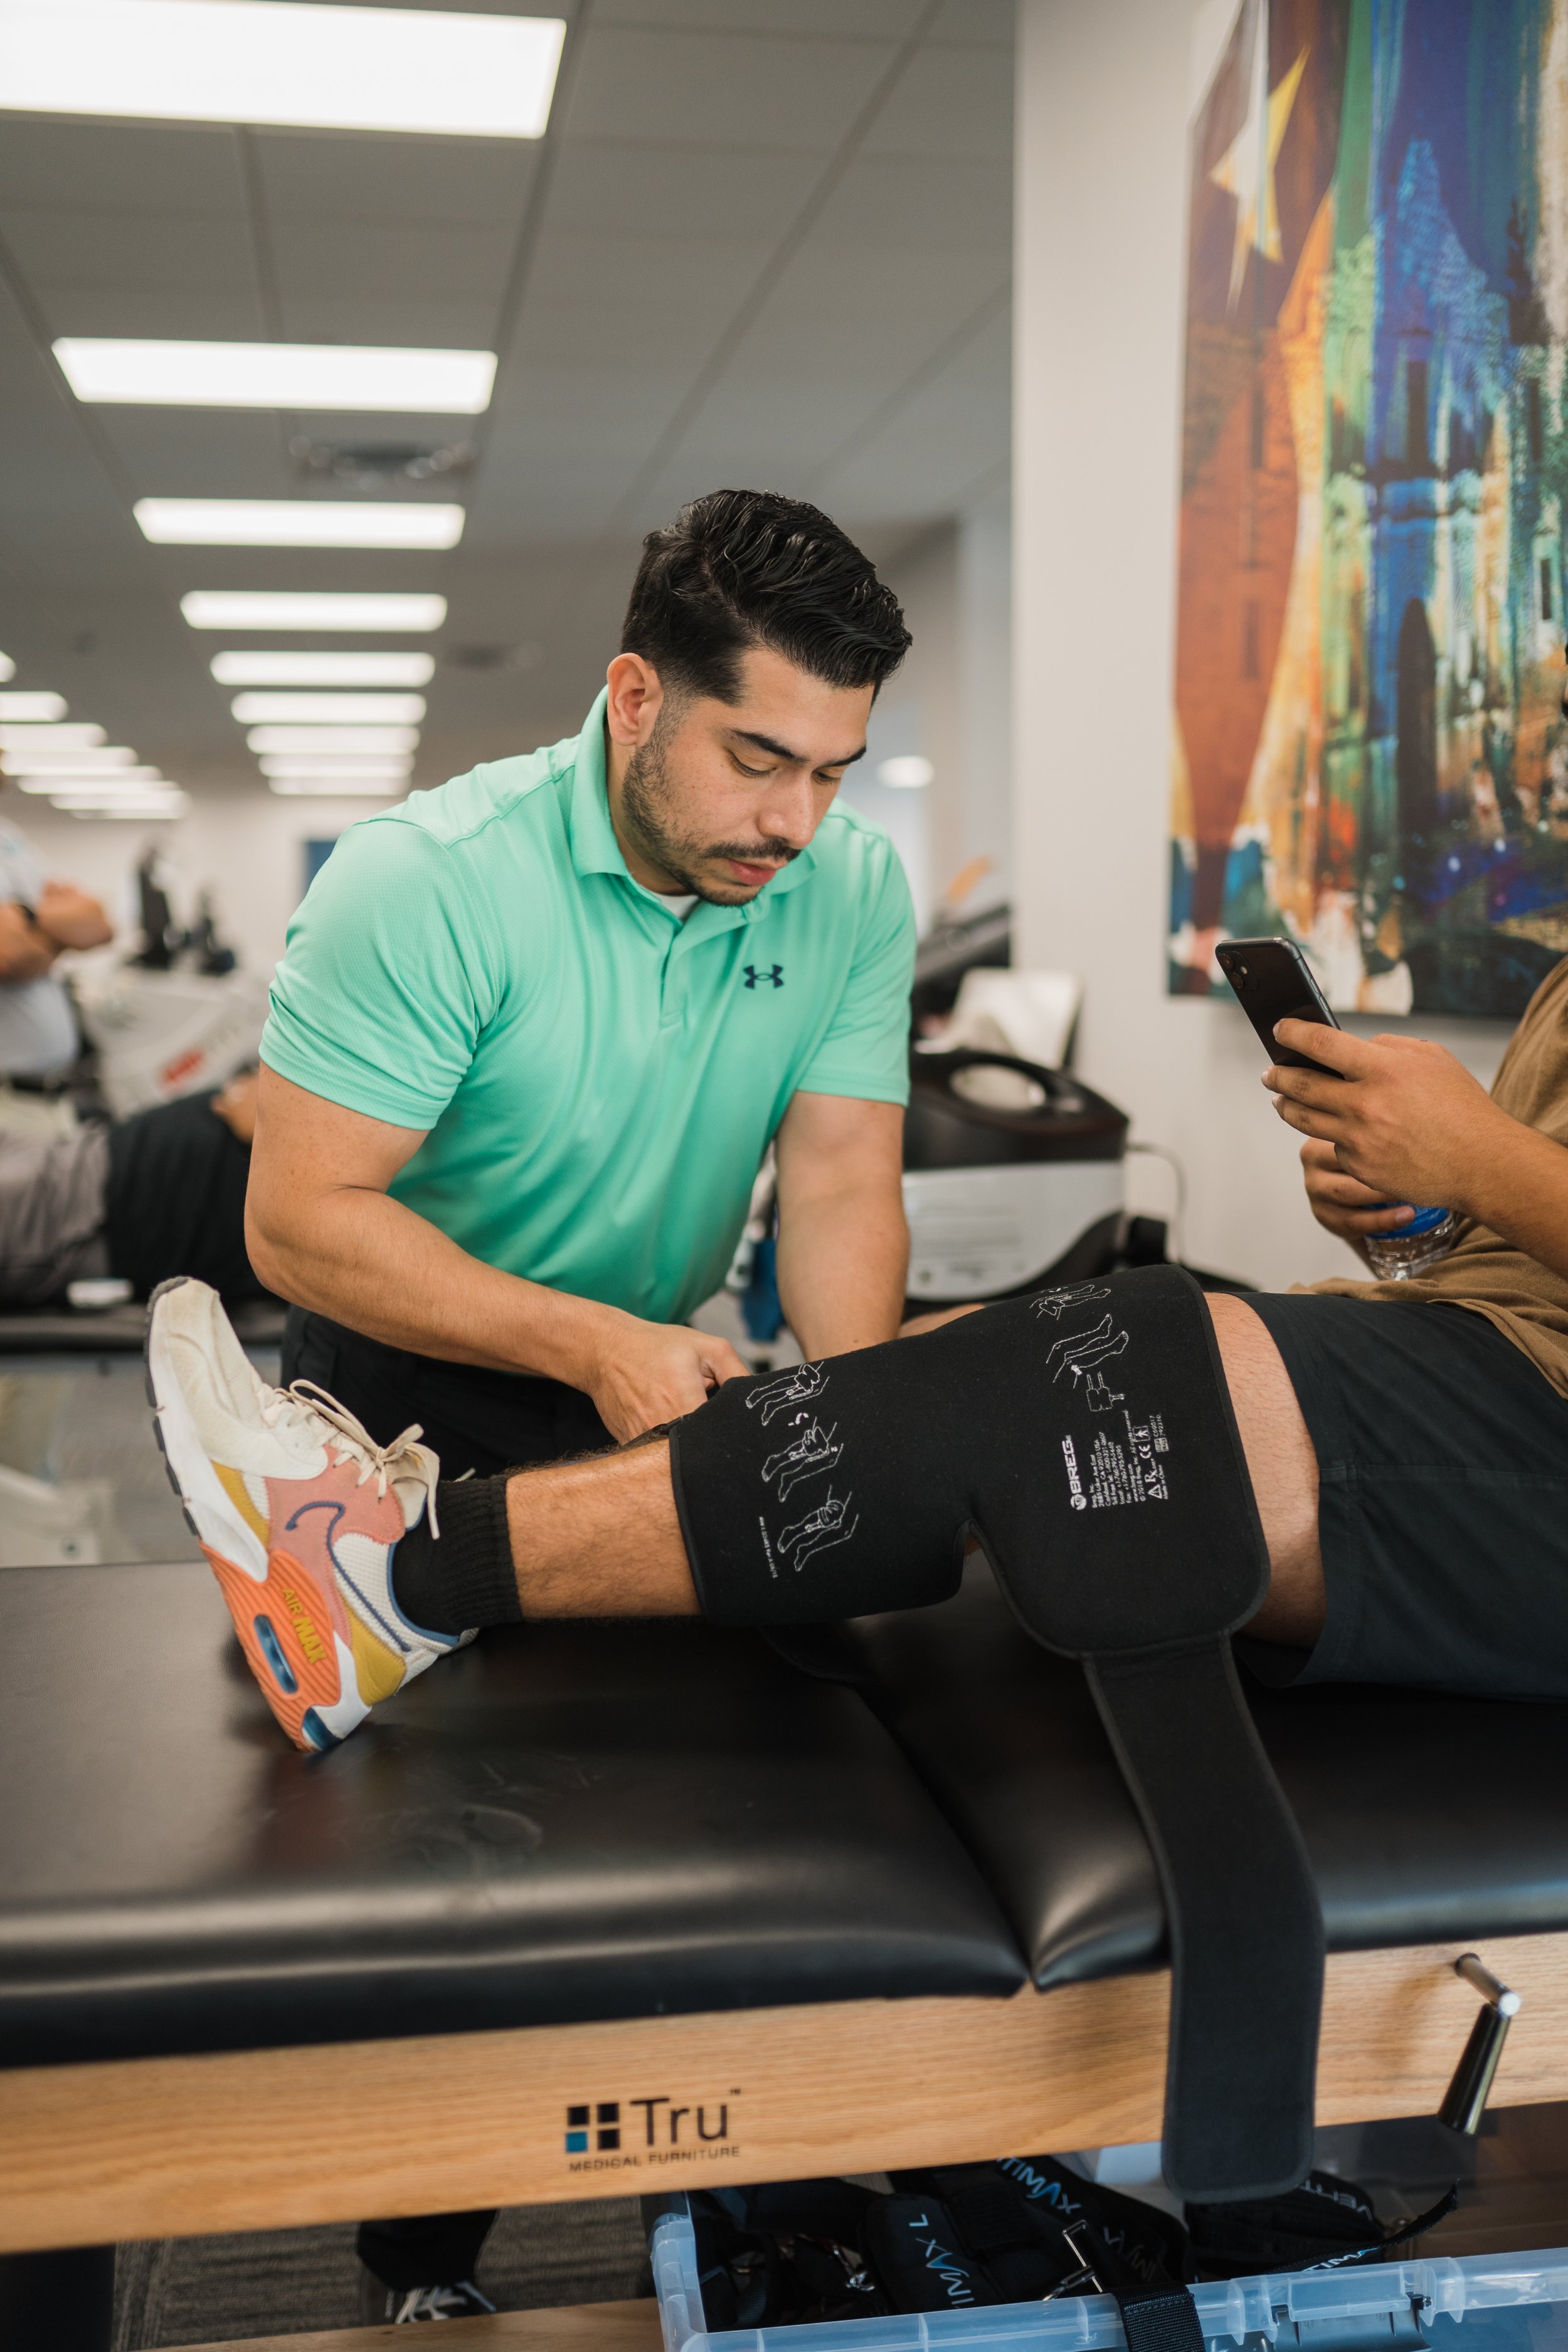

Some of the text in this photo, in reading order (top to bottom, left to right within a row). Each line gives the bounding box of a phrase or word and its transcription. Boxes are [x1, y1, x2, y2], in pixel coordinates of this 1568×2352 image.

[1061, 1438, 1082, 1494] BREG
[1096, 1451, 1104, 1470] 92010
[1099, 1470, 1106, 1480] CA
[1136, 1480, 1144, 1495] 2018
[282, 1589, 326, 1663] AIR MAX
[630, 2097, 729, 2146] Tru
[569, 2146, 741, 2173] MEDICAL FURNITURE
[999, 2156, 1083, 2215] TIMAX
[914, 2237, 975, 2309] IMAX
